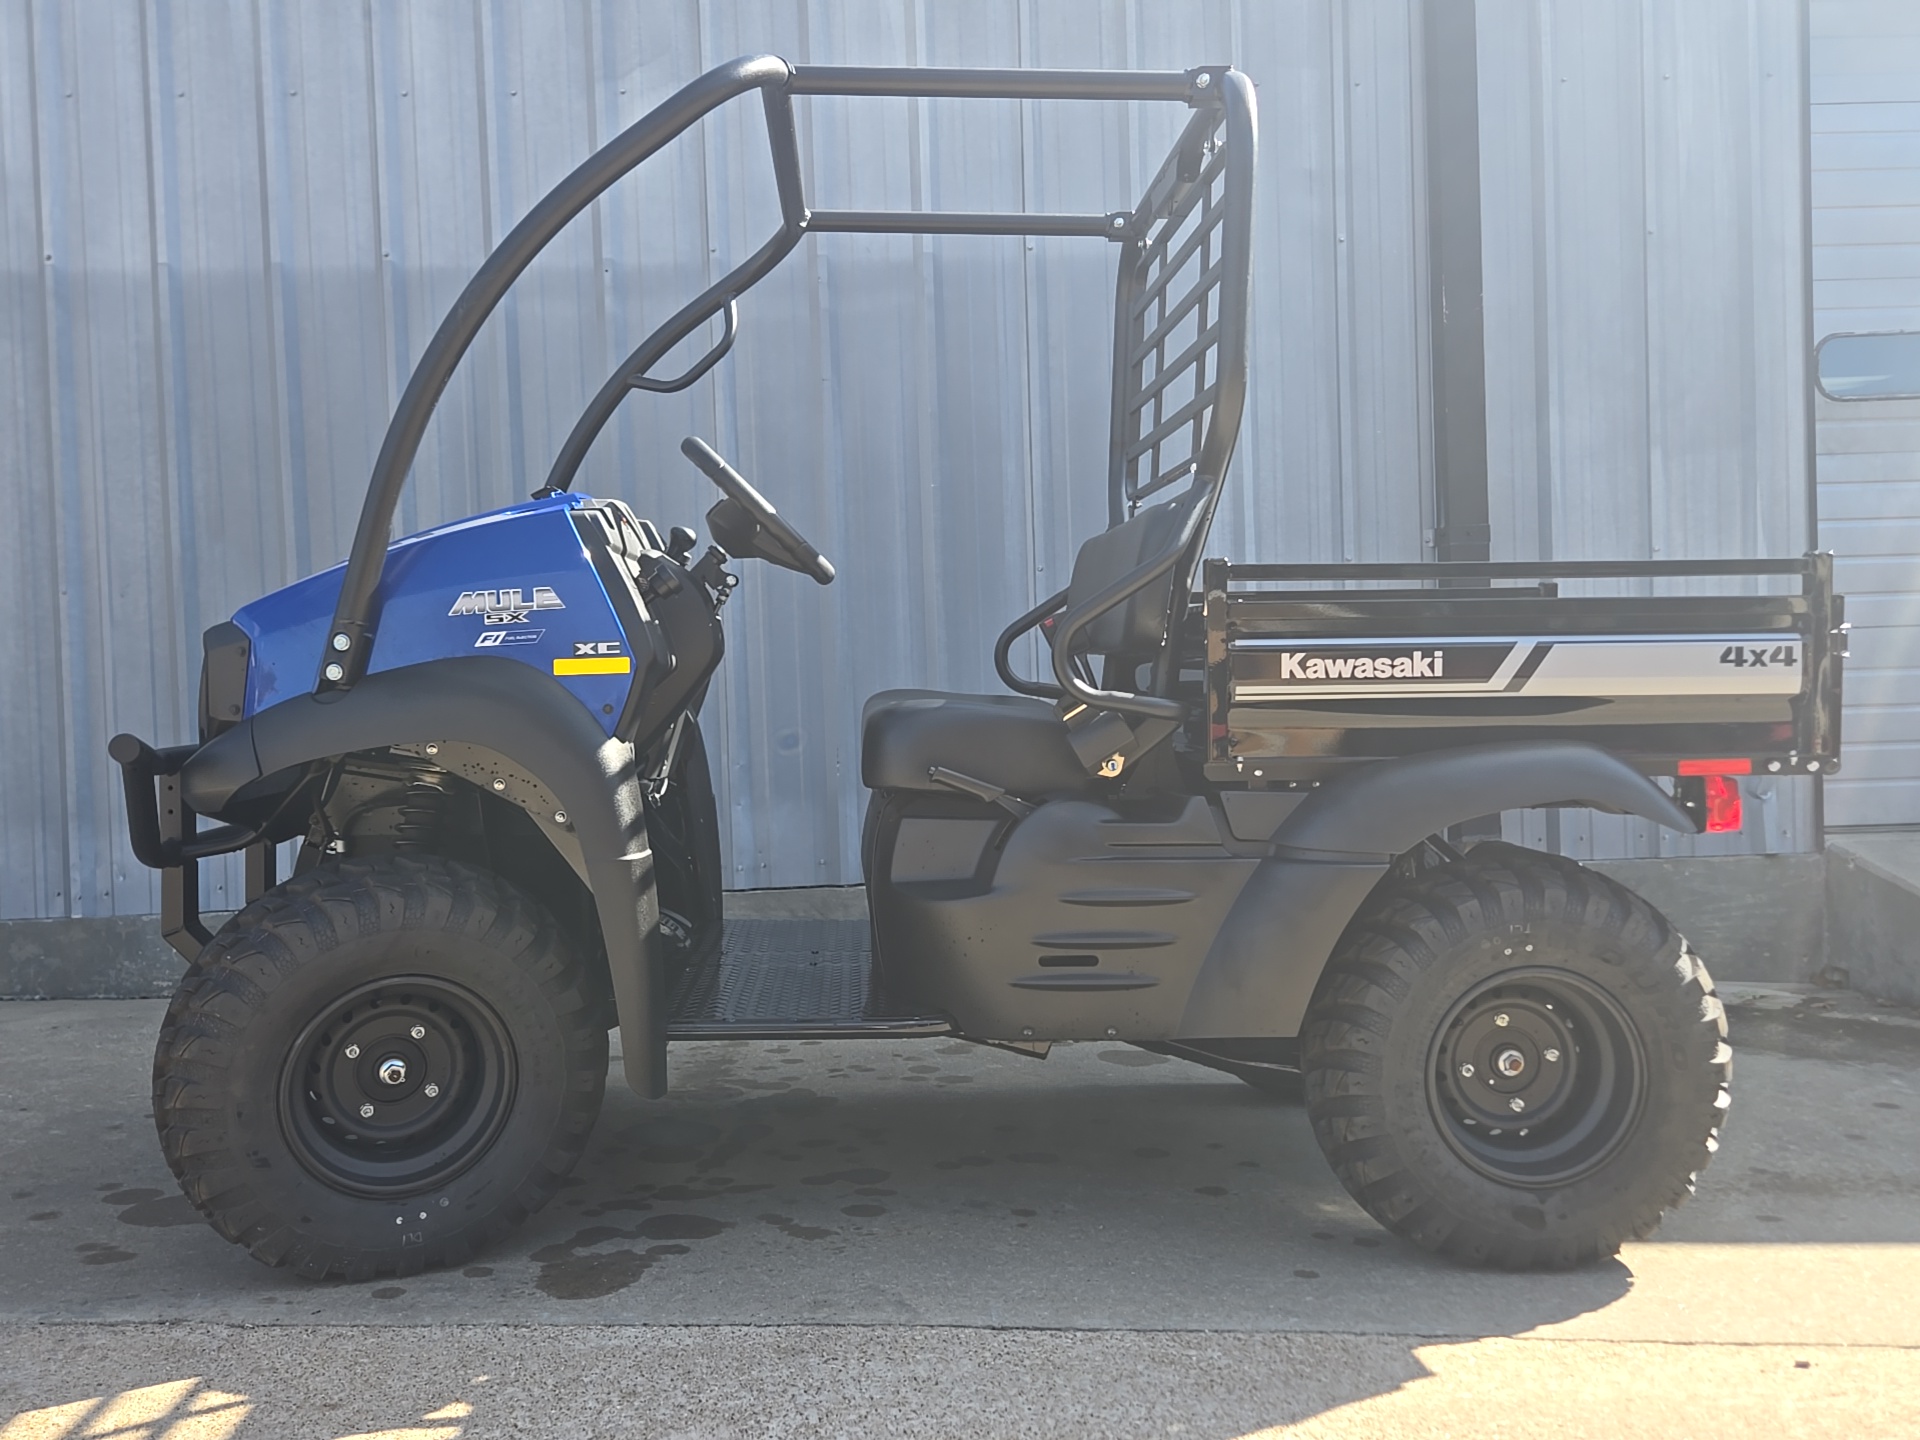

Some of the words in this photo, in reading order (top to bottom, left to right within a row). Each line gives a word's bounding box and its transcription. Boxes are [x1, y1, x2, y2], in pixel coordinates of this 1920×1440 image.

[448, 587, 566, 616] MULE
[484, 611, 530, 625] SX
[574, 642, 620, 655] XC
[1719, 645, 1798, 668] 4x4
[1280, 651, 1444, 679] Kawasaki
